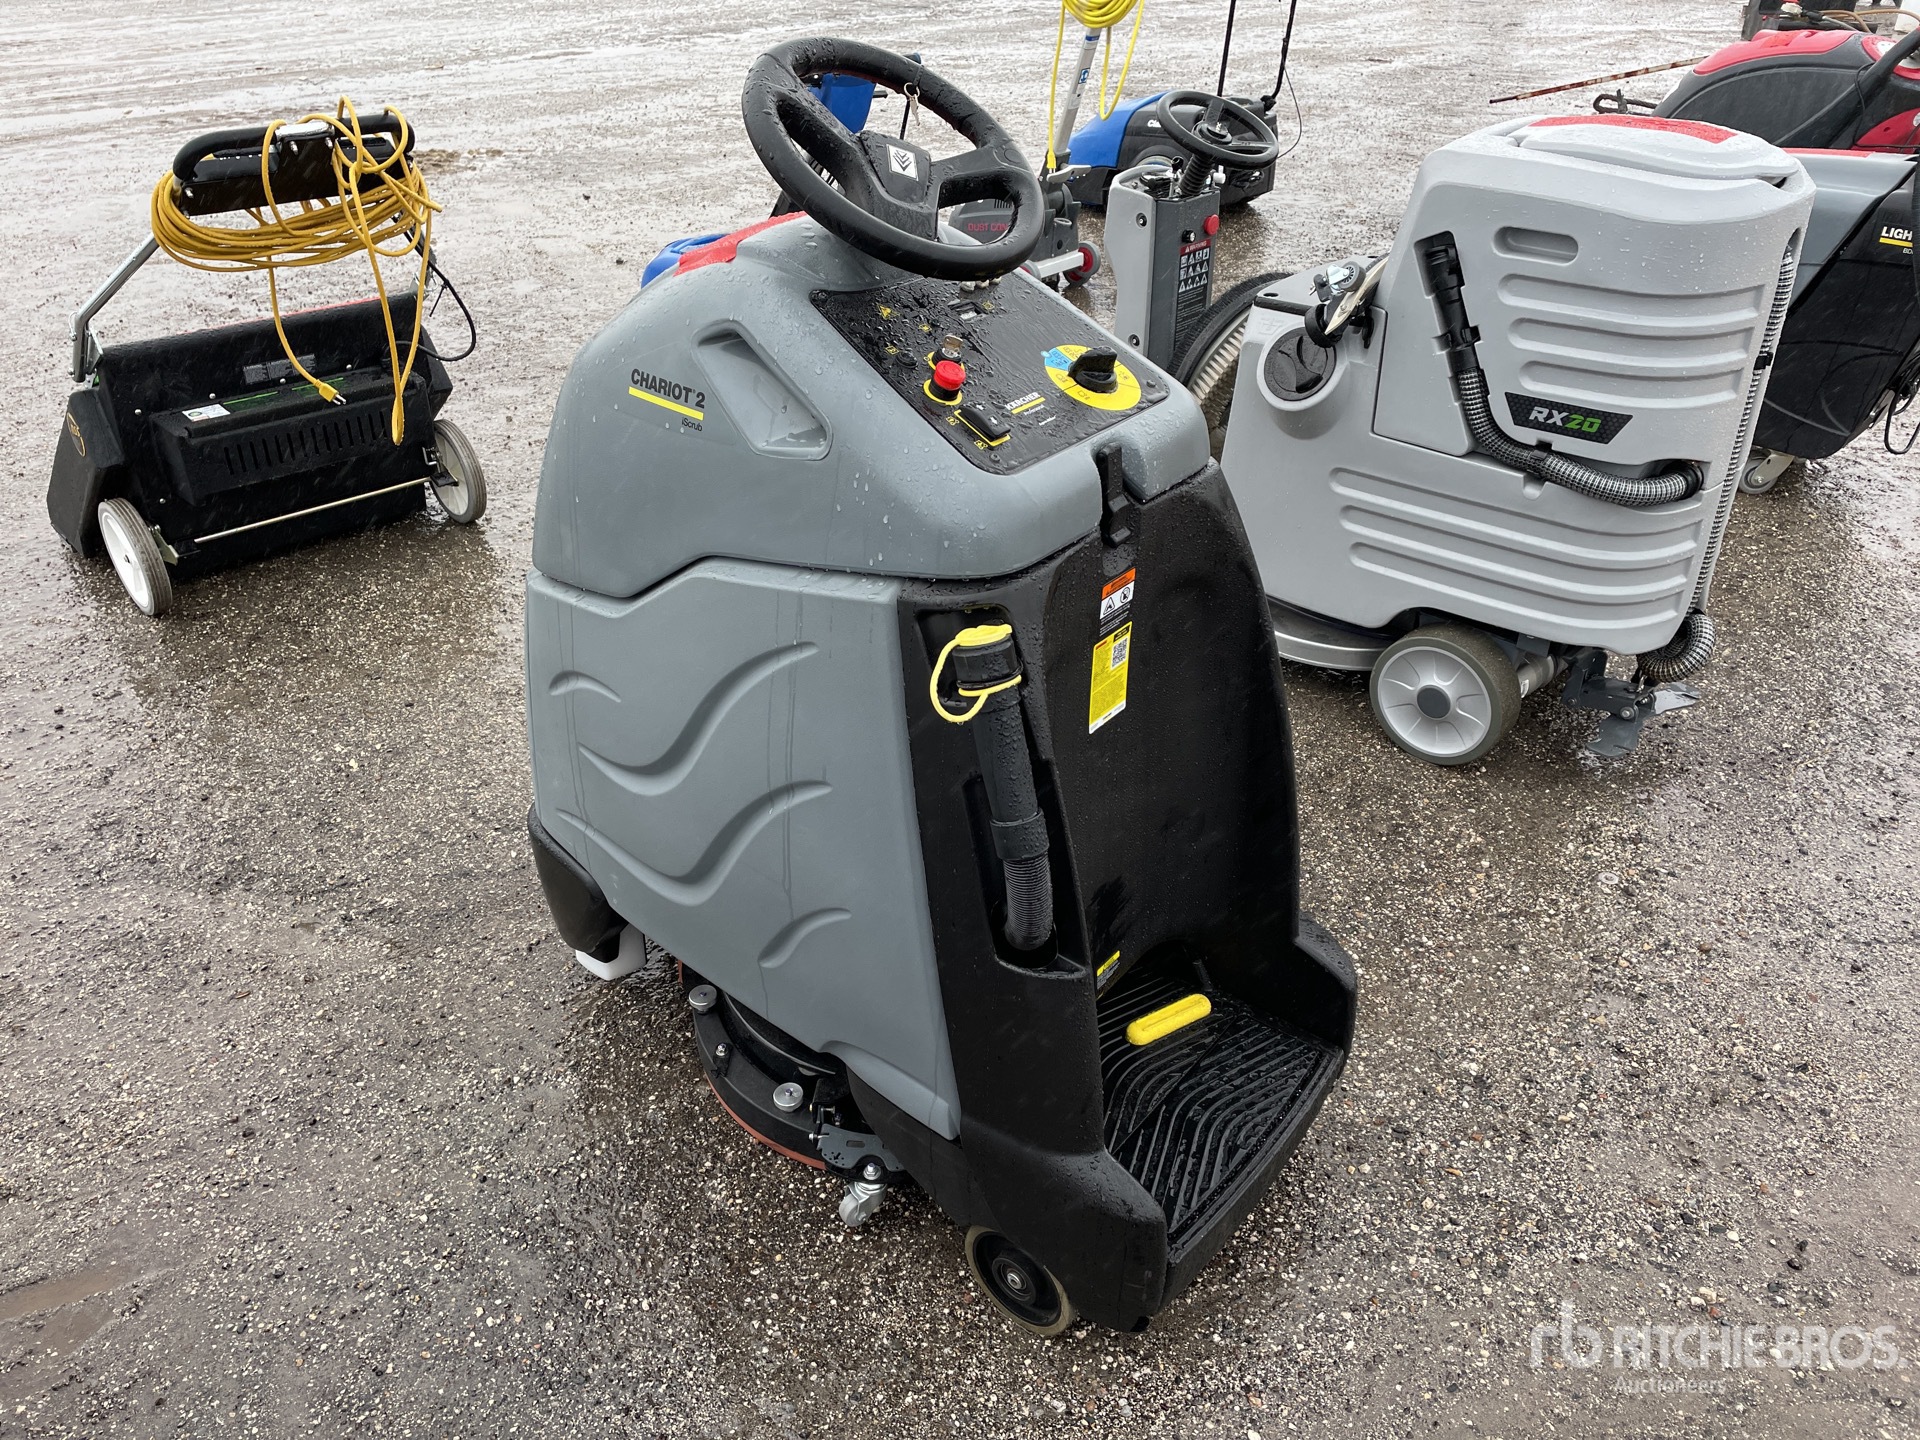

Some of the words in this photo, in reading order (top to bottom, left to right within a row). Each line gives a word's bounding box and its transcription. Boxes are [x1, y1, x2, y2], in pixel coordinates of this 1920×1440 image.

[968, 223, 988, 231] DUST
[631, 368, 692, 404] CHARIOT
[695, 391, 706, 409] 2
[681, 417, 703, 432] iScrub
[1529, 406, 1602, 433] RX20
